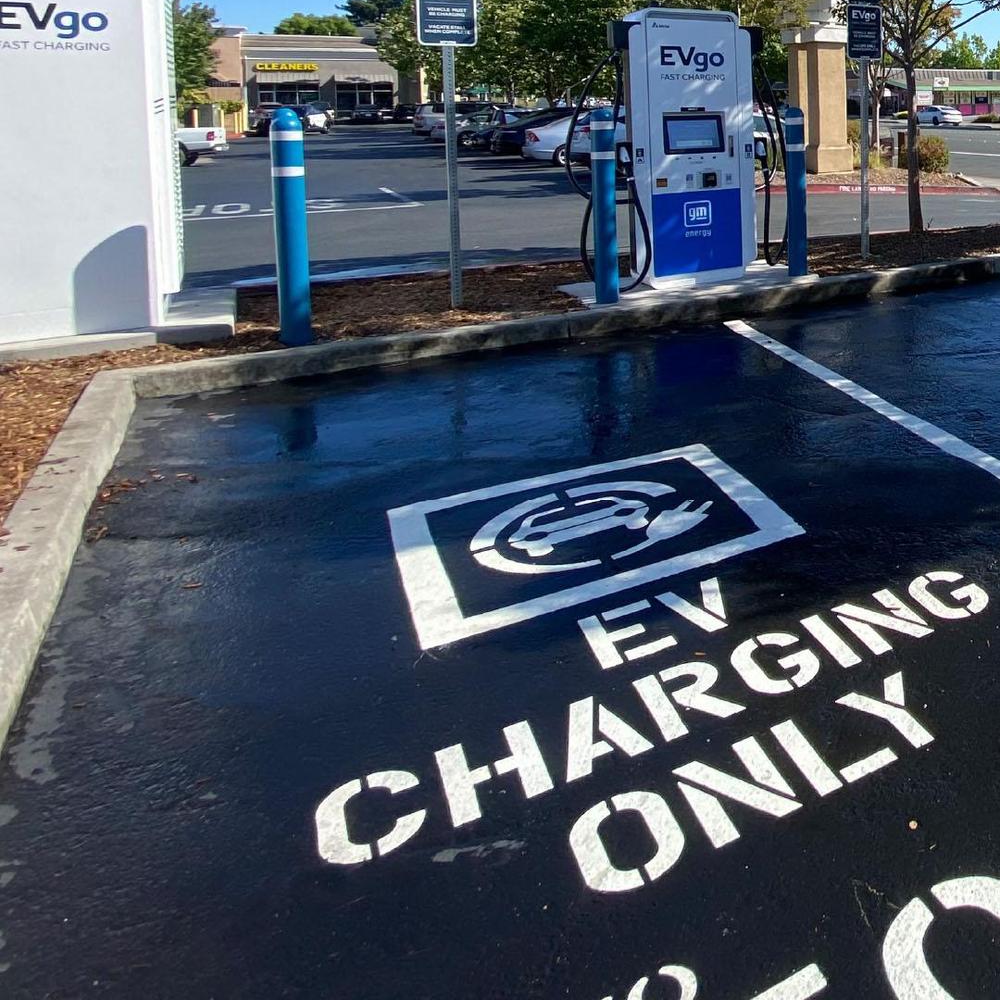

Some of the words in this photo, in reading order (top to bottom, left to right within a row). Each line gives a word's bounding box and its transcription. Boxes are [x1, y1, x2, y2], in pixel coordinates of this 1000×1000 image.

[0, 1, 108, 39] EVgo
[852, 10, 876, 22] EVgo
[34, 40, 110, 51] CHARGING
[256, 63, 319, 71] CLEANERS
[660, 46, 725, 72] EVgo
[688, 206, 707, 220] gm
[685, 229, 712, 237] energy
[577, 578, 728, 670] EV
[314, 570, 989, 864] CHARGING
[568, 671, 935, 893] ONLY
